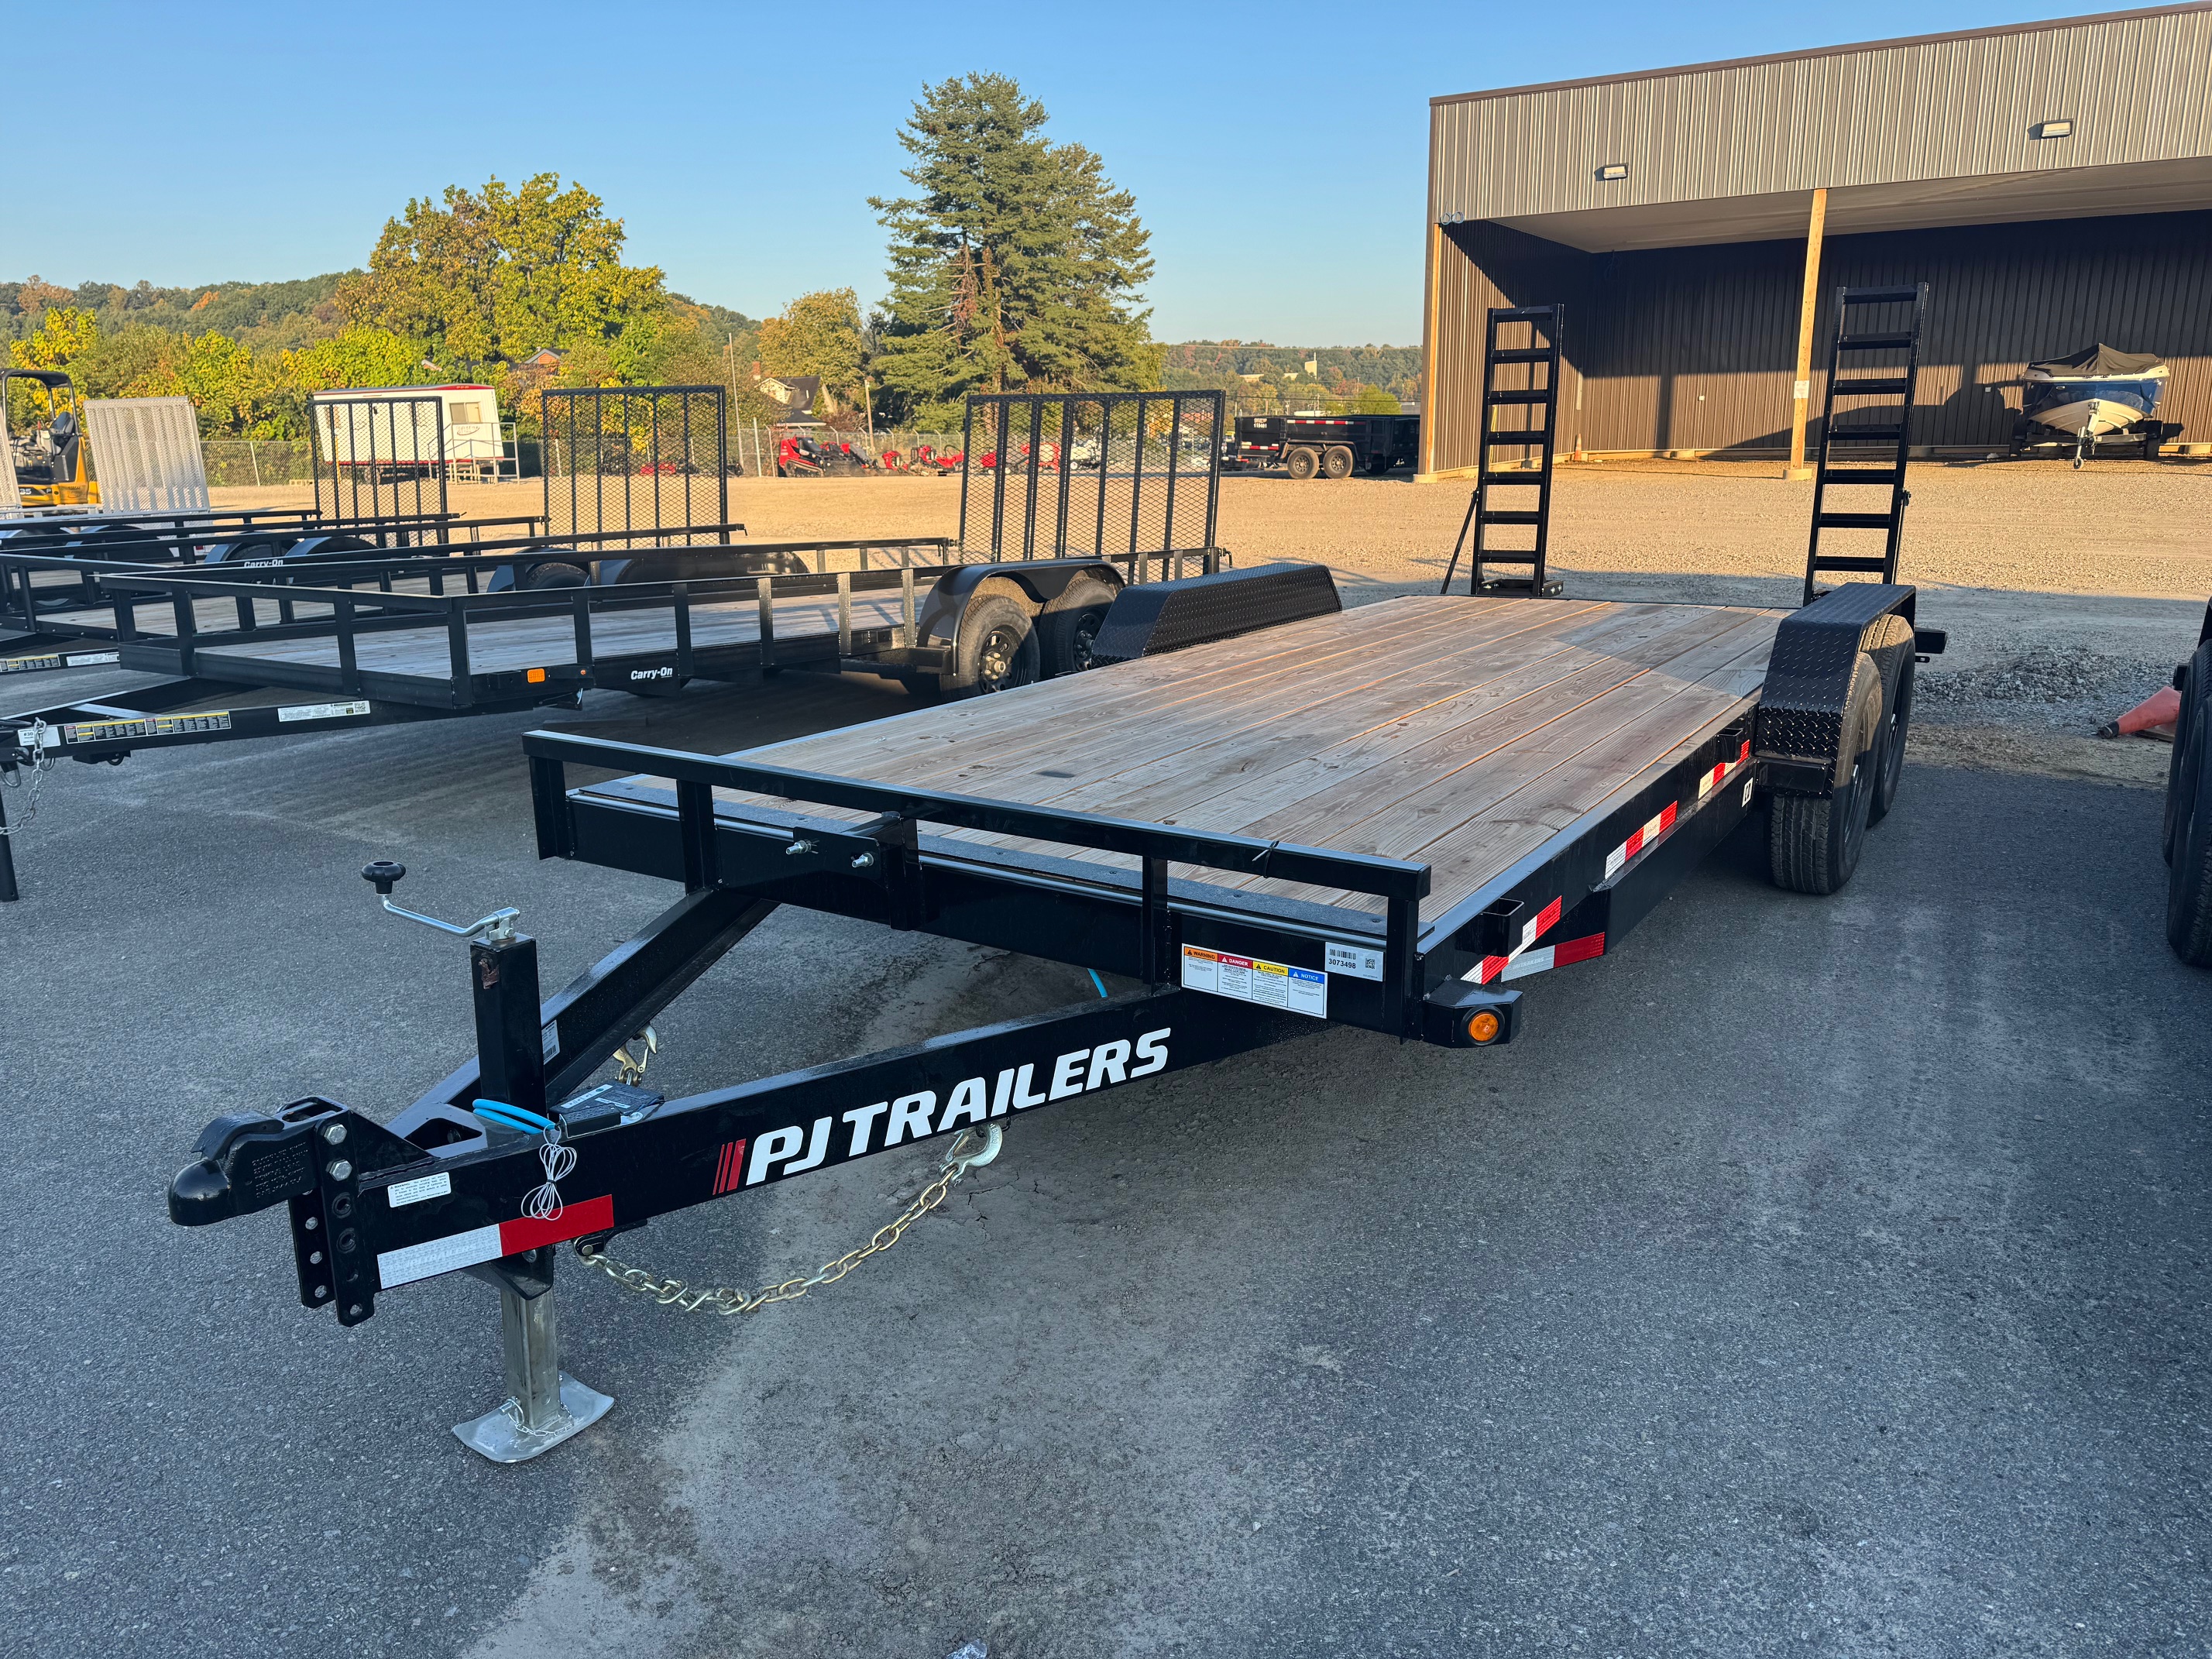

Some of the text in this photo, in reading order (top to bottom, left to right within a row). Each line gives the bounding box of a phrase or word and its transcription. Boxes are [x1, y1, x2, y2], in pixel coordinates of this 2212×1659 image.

[630, 667, 673, 680] Carry-On
[1194, 951, 1215, 960] WARNING
[1228, 958, 1249, 967] DANGER
[1328, 958, 1356, 969] 3073498
[1263, 965, 1285, 974] CAUTION
[746, 1028, 1171, 1186] PJ TRAILERS
